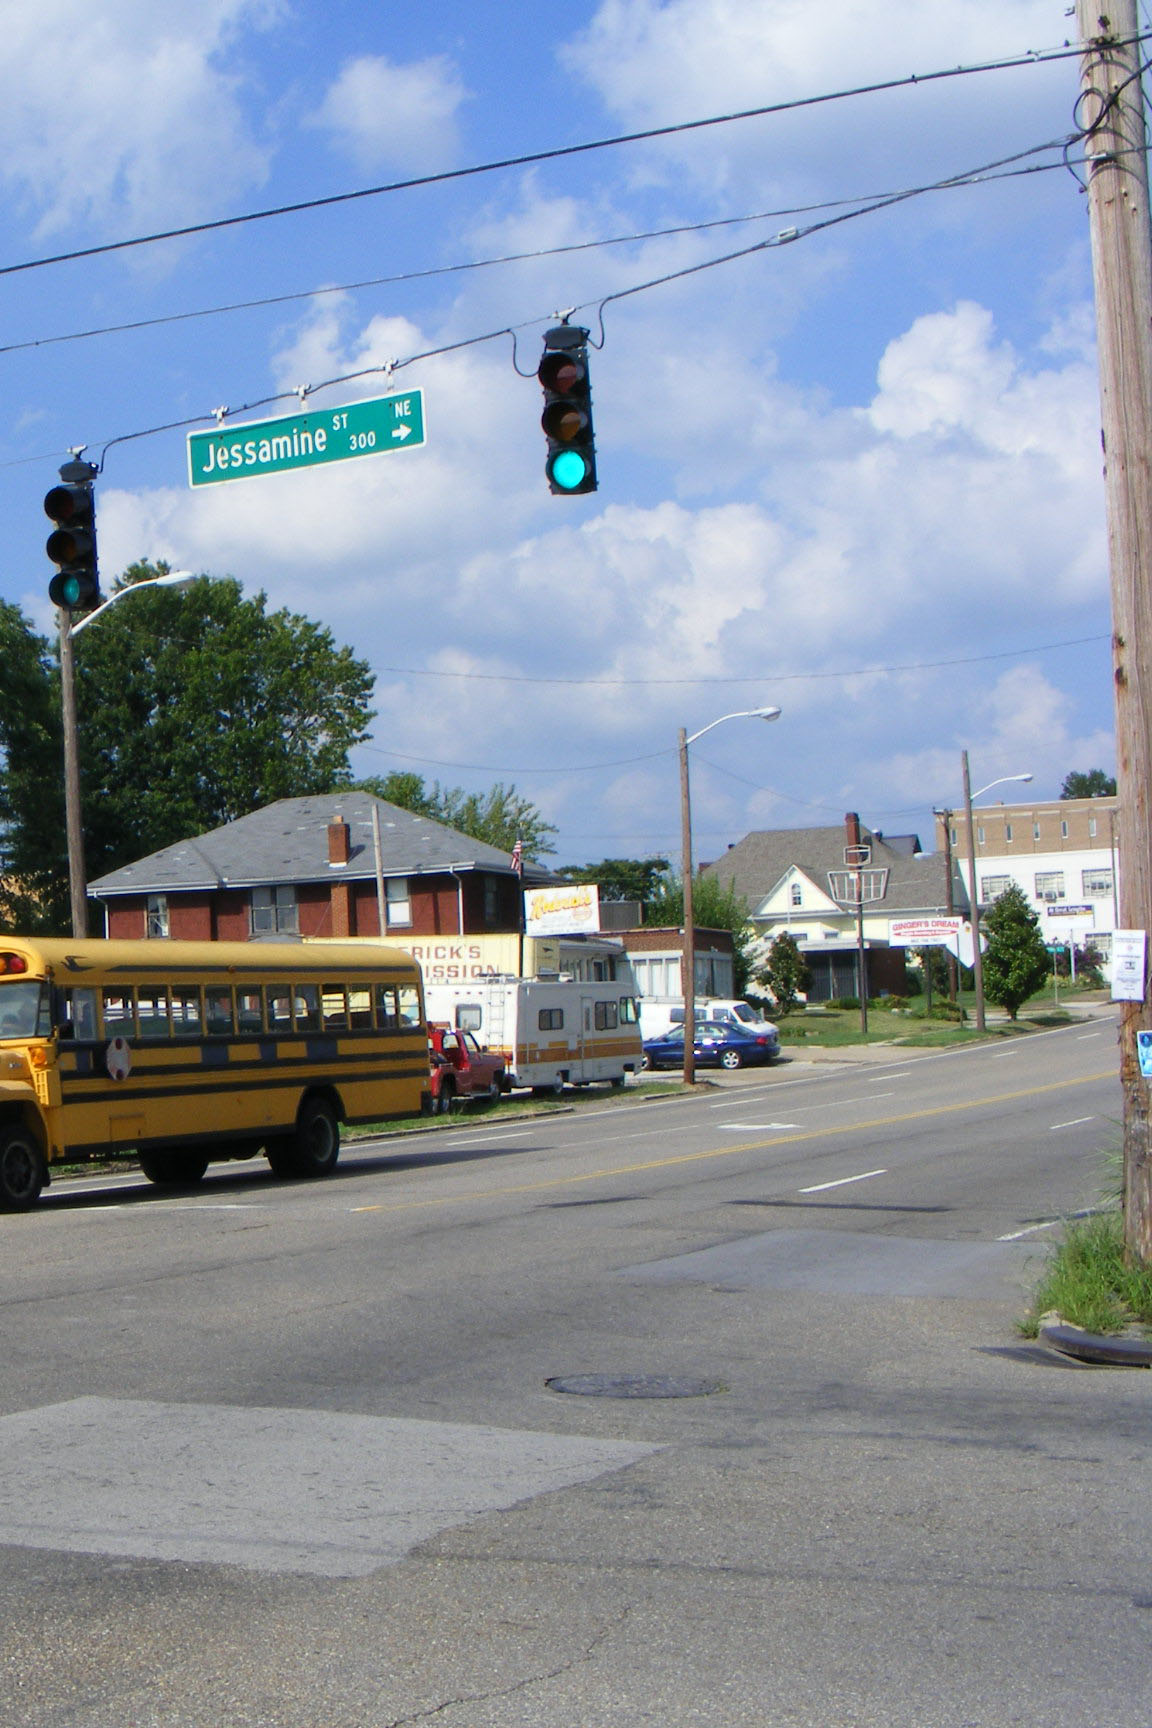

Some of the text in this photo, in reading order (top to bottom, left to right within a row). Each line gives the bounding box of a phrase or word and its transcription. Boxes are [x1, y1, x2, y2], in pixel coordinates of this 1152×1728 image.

[203, 400, 411, 473] Jessamine ST NE
[349, 431, 376, 451] 300
[399, 945, 481, 960] RICK'S
